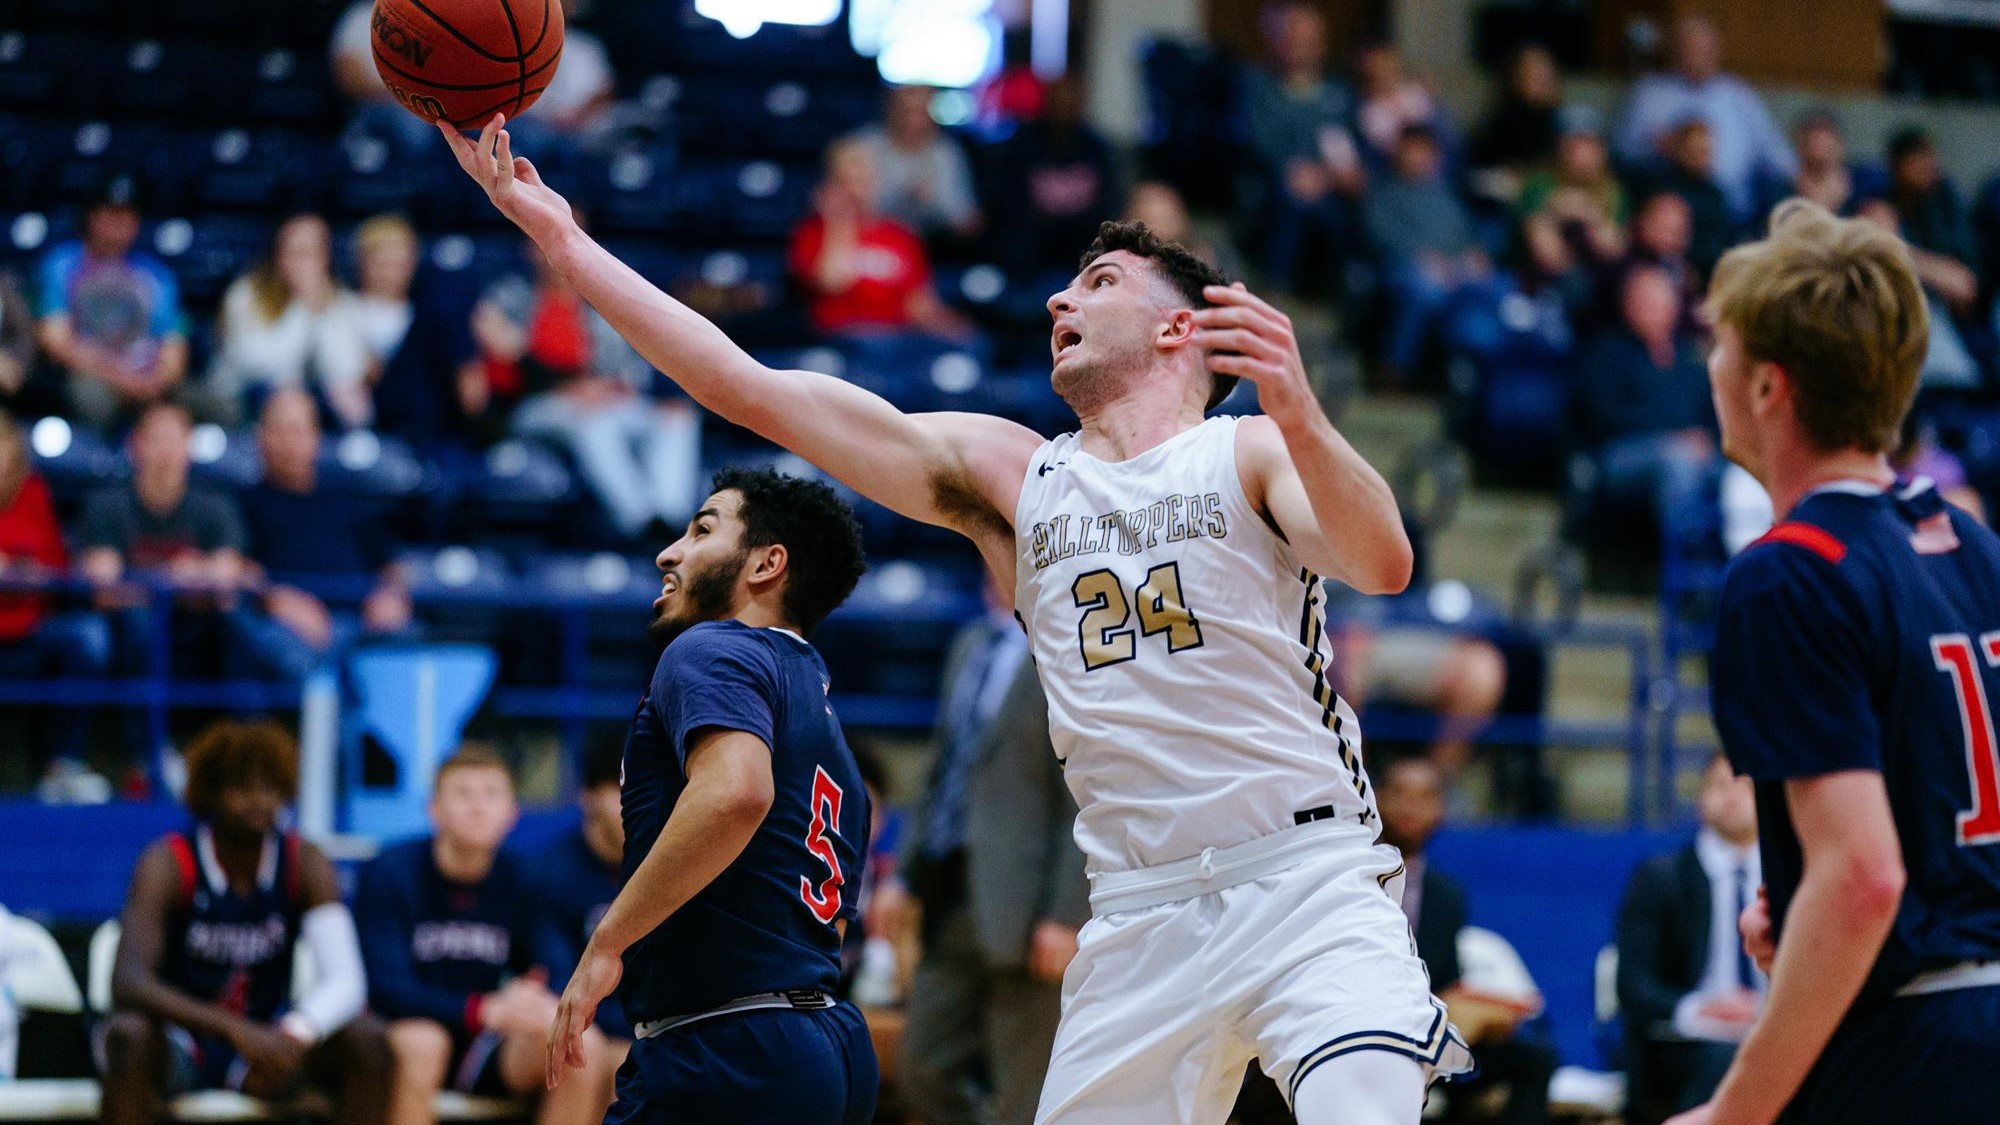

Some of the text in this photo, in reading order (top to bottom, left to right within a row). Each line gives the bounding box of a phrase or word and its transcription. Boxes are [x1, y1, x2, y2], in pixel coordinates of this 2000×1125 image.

[1032, 492, 1227, 571] HILLTOPPERS
[1071, 560, 1204, 672] 24
[800, 764, 844, 925] 5
